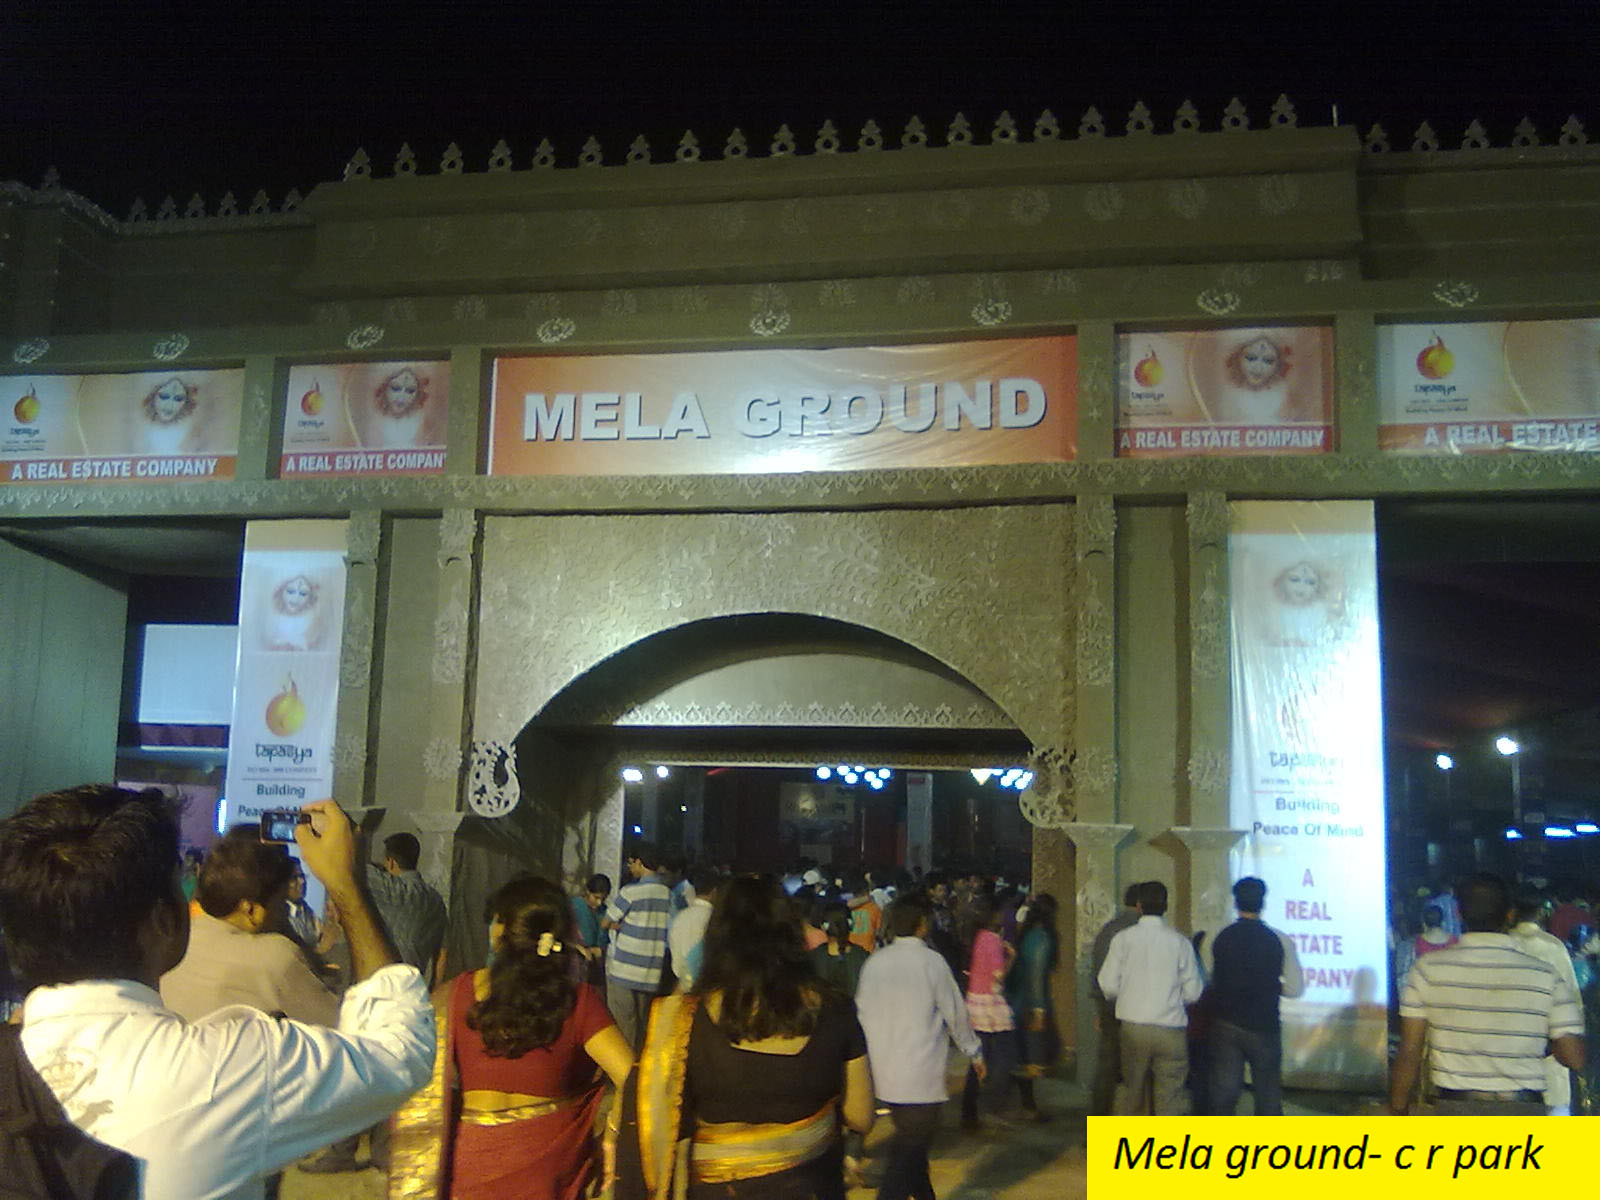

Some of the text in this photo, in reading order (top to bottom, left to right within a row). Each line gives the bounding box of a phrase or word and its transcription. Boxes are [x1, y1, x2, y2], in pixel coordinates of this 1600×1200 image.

[523, 378, 1048, 442] MELA GROUND
[1120, 429, 1324, 449] A REAL ESTATE COMPANY
[1425, 421, 1598, 447] A REAL ESTATE
[11, 457, 218, 480] A REAL ESTATE COMPANY
[286, 456, 295, 472] A
[299, 455, 332, 471] REAL
[335, 453, 384, 470] ESTATE
[256, 784, 306, 799] Building
[1253, 821, 1299, 836] Peace
[1304, 823, 1321, 836] Of
[1302, 868, 1315, 888] A
[1285, 900, 1332, 921] REAL
